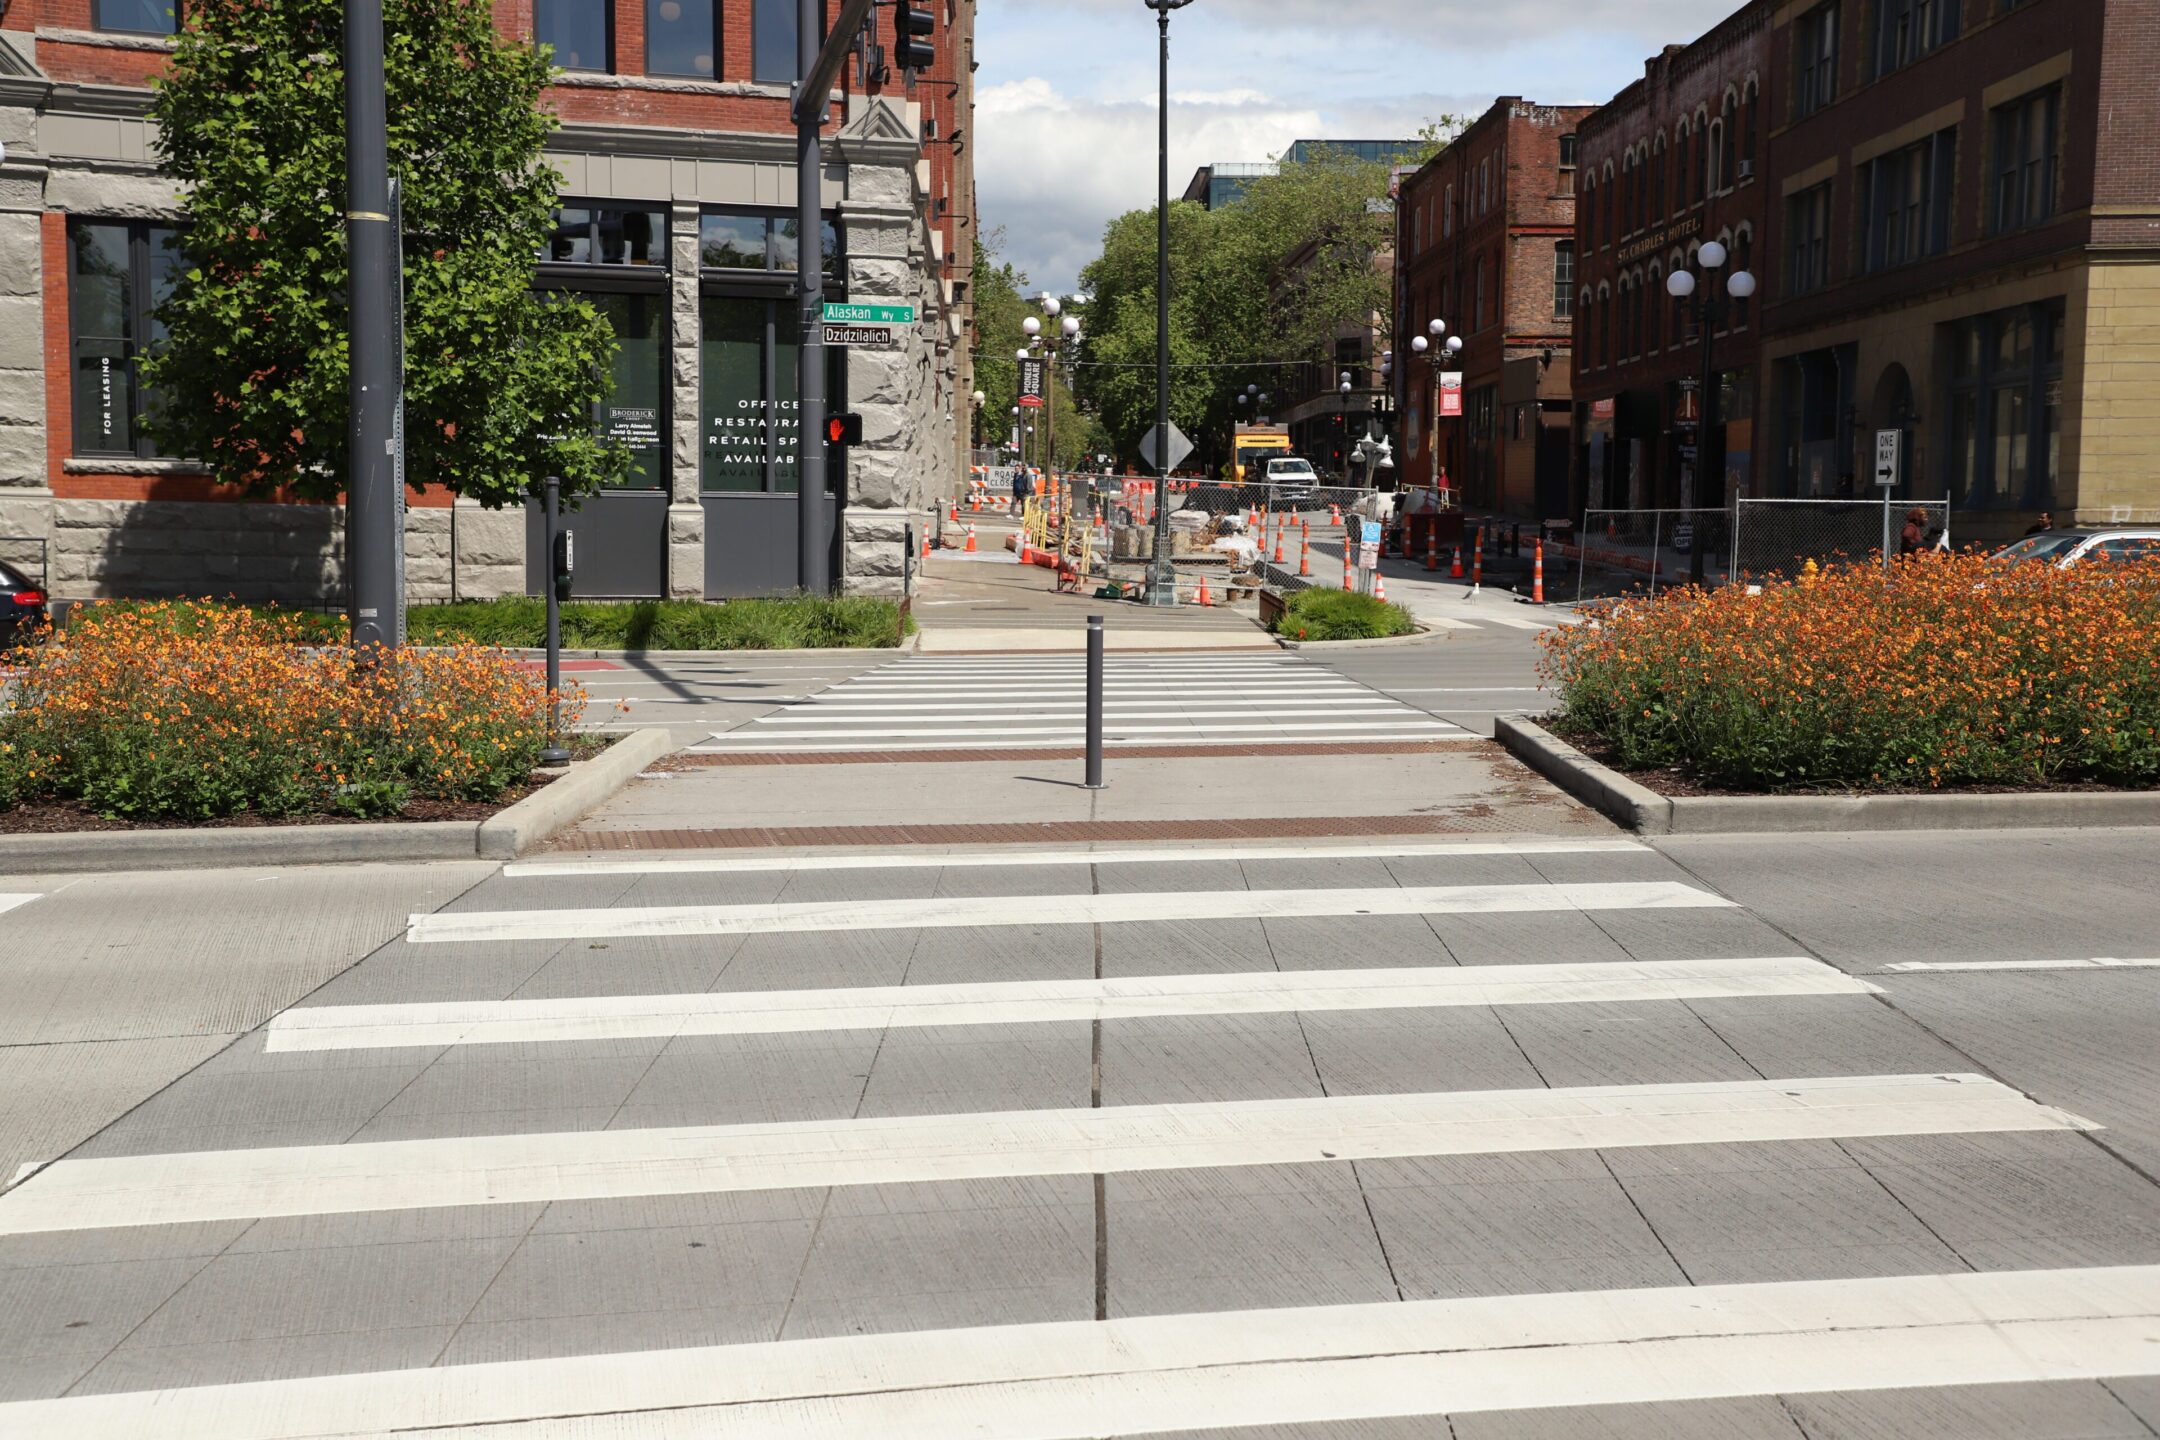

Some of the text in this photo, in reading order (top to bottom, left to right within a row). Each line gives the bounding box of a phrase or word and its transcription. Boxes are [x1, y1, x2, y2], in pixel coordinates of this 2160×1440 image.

[1629, 231, 1665, 258] CHARLES
[827, 305, 910, 322] Alaskan Wy S
[826, 328, 889, 343] Dzidzilalich
[1023, 362, 1033, 393] PIONEER
[1031, 362, 1040, 395] SQUARE
[101, 356, 112, 435] FOR LEASING
[738, 399, 799, 409] OFFICE
[612, 410, 653, 418] BRODERICK
[714, 417, 799, 428] RESTAURA
[709, 436, 768, 446] RETAIL
[1880, 434, 1894, 447] ONE
[724, 454, 795, 464] AVAILAB
[1879, 449, 1894, 462] WAY
[994, 470, 1015, 478] ROAD
[990, 479, 1014, 487] CLOSE
